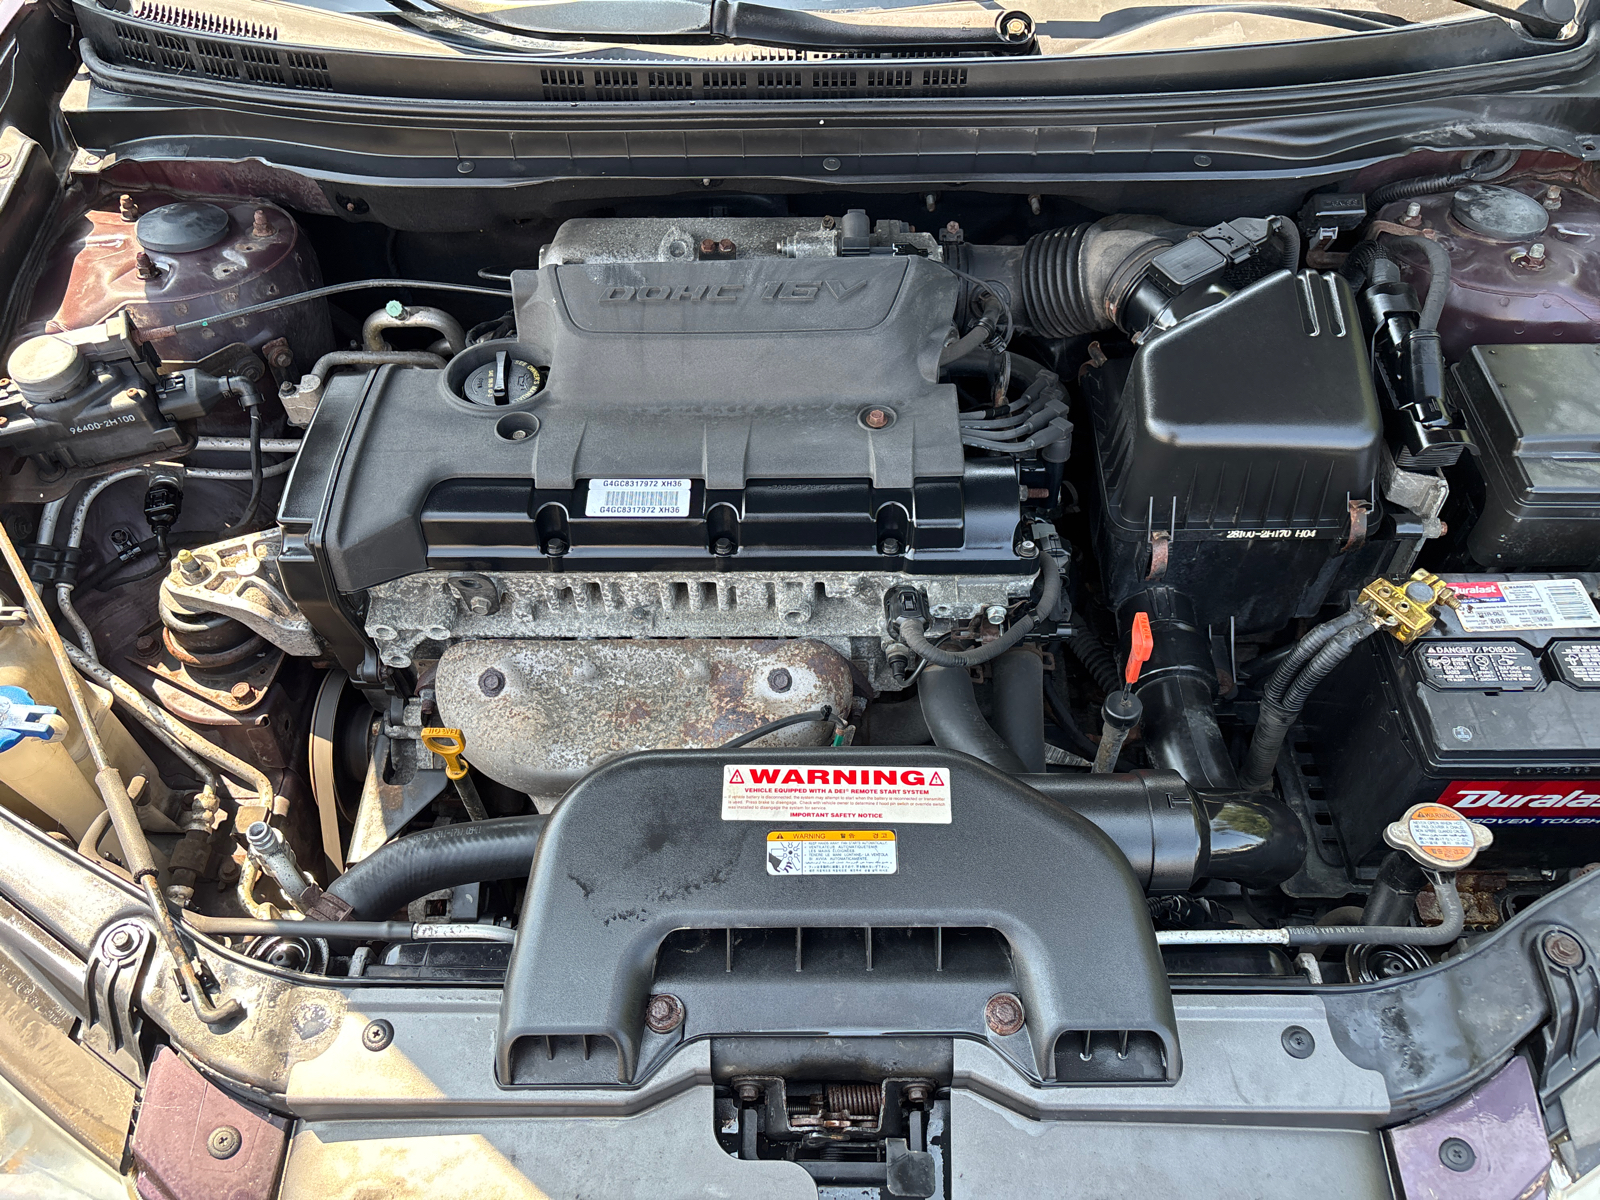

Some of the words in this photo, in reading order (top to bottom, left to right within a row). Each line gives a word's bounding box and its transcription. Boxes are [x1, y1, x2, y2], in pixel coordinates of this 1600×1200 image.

[598, 284, 743, 303] DOHC
[69, 414, 136, 435] 96400-2H100
[1294, 529, 1318, 538] H04
[749, 769, 925, 785] WARNING
